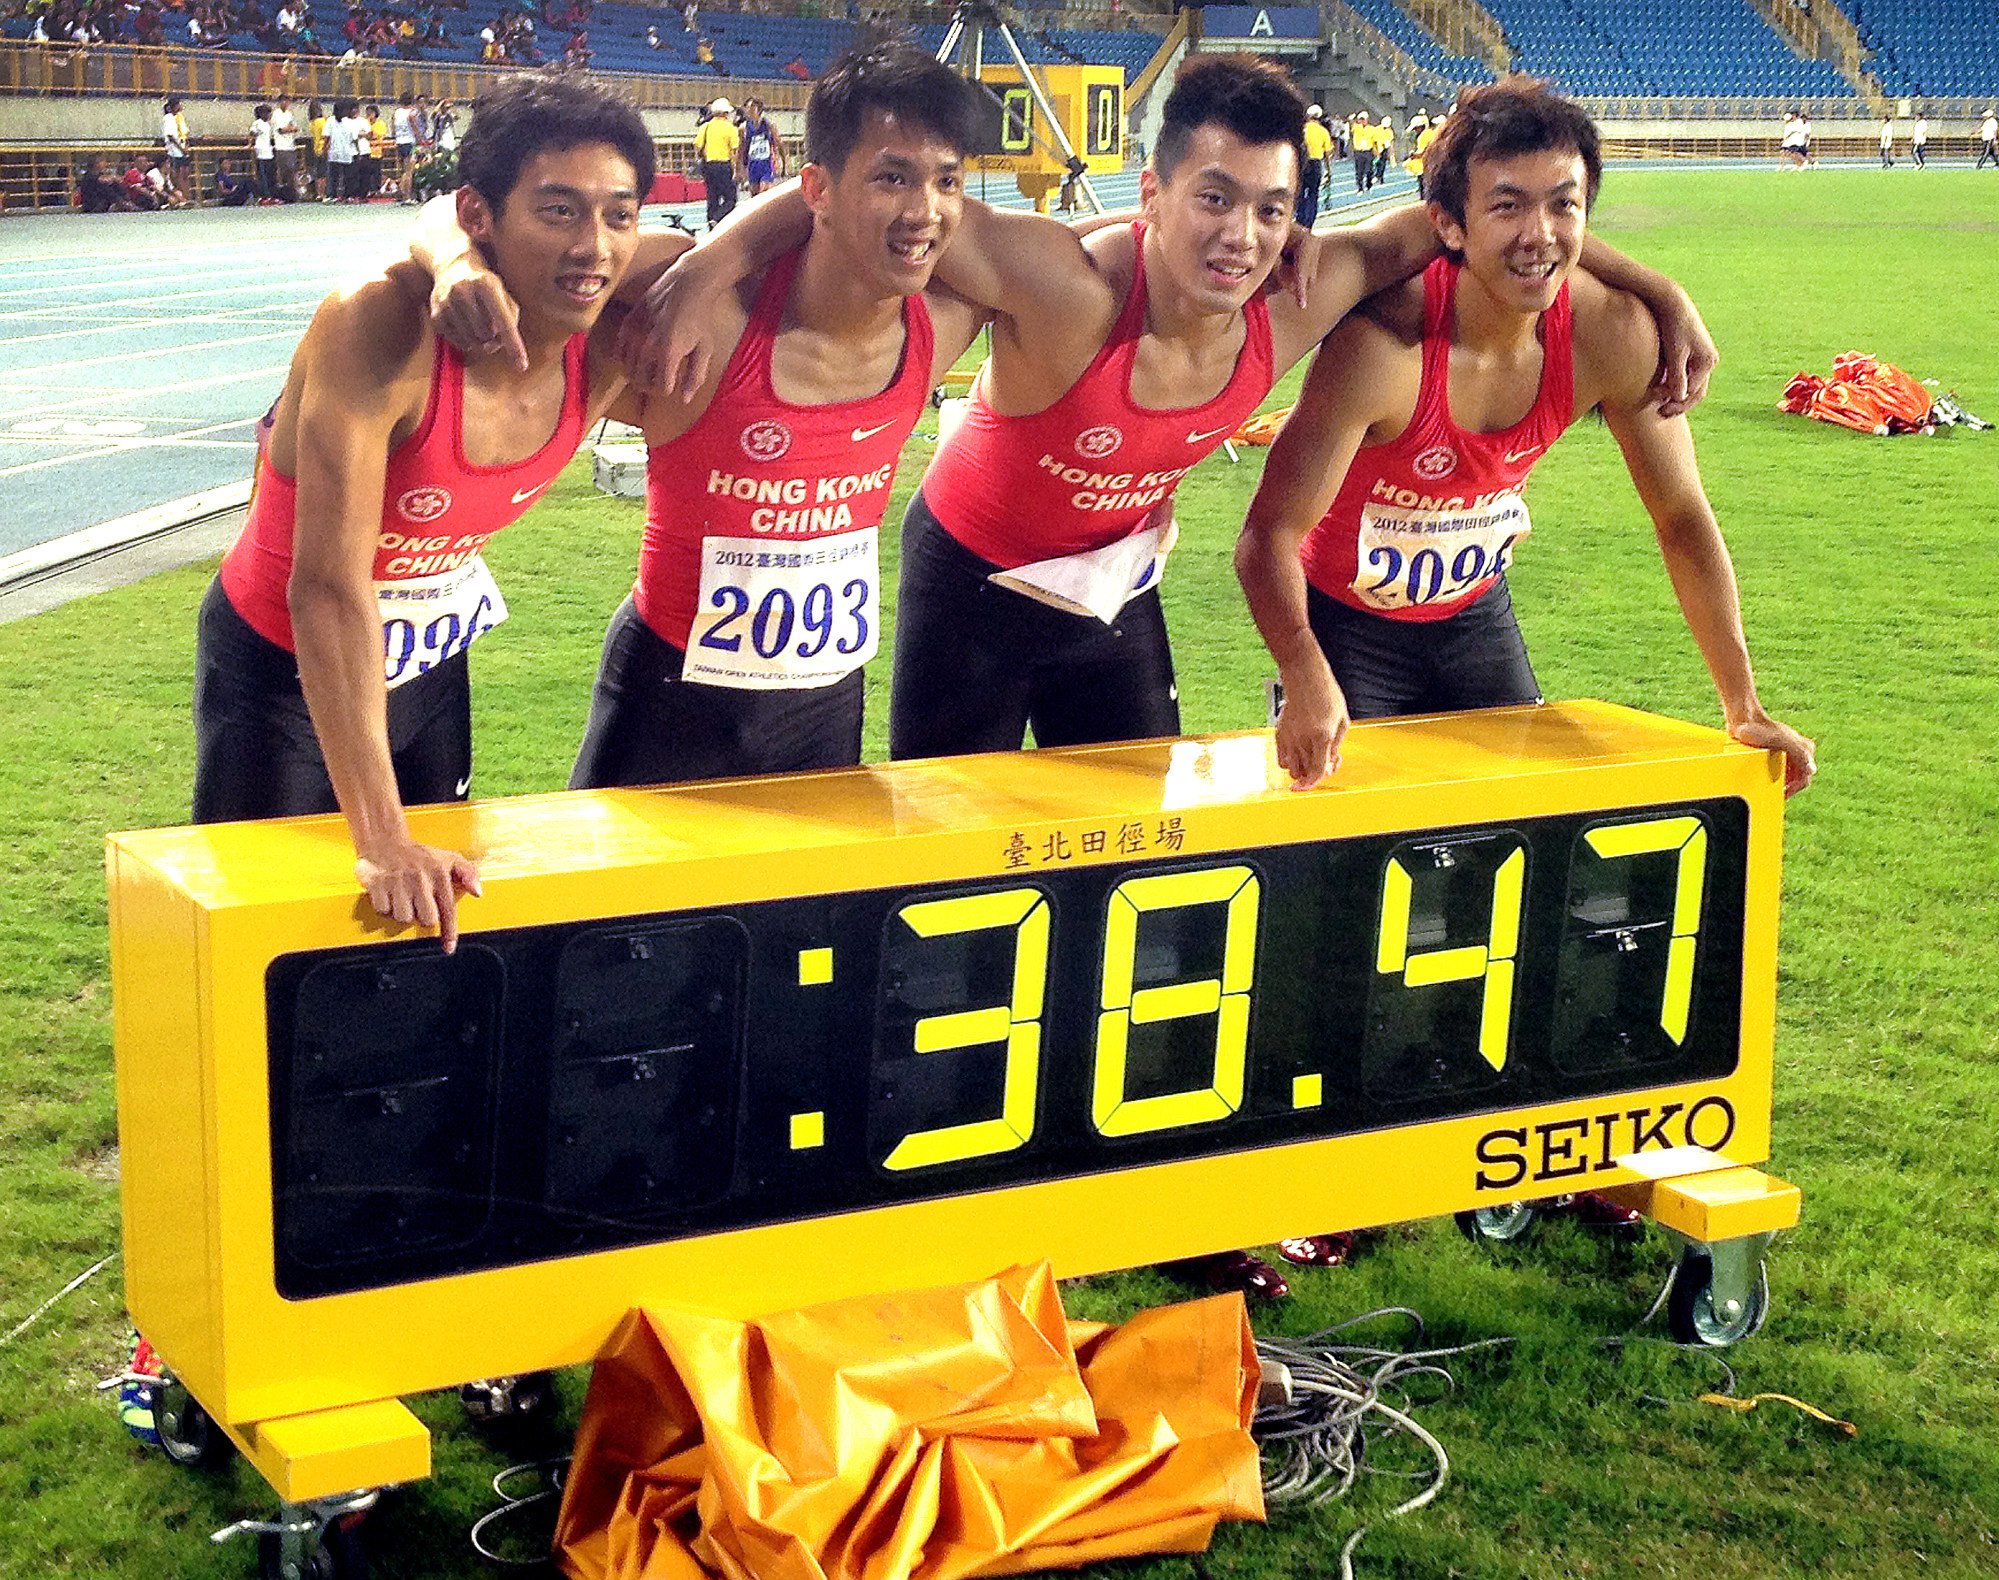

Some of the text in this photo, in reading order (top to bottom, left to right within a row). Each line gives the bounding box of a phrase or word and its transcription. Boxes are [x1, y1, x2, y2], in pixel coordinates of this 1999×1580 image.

[1249, 9, 1274, 37] A
[1097, 89, 1113, 151] 0
[708, 463, 891, 505] HONG KONG
[1038, 454, 1134, 489] HONG
[1072, 486, 1165, 511] CHINA
[752, 504, 852, 533] CHINA
[379, 532, 452, 552] ONG
[385, 547, 478, 574] CHINA
[698, 579, 869, 659] 2093
[1003, 817, 1187, 870] 臺北田徑場
[1475, 1095, 1736, 1190] SEIKO
